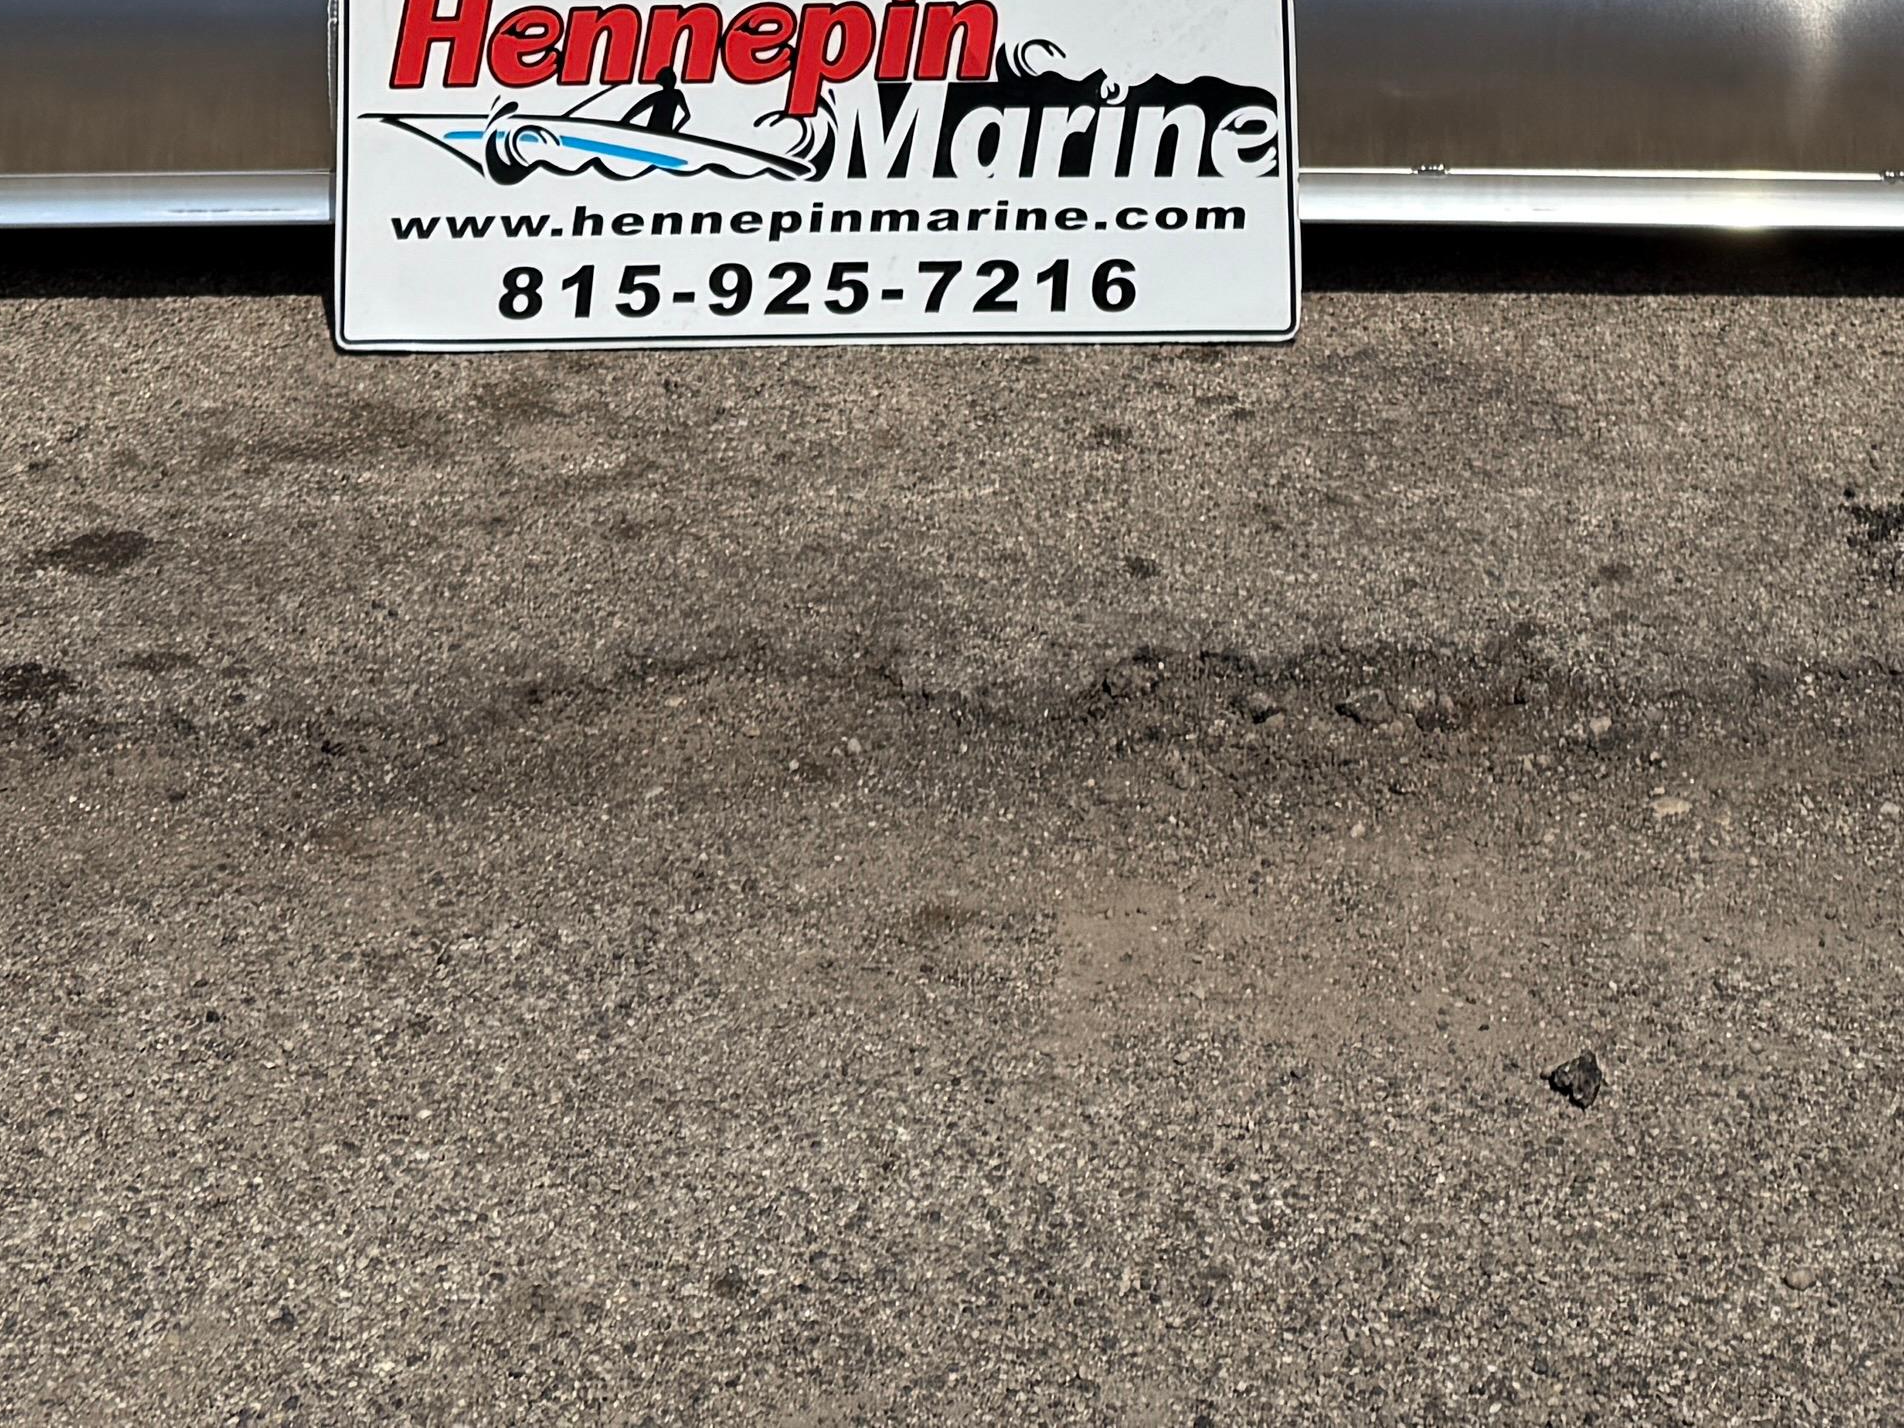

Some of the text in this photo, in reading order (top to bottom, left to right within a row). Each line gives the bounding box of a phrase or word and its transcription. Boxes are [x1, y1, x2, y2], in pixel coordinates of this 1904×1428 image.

[824, 71, 1280, 180] Marine
[392, 201, 1245, 241] www.hennepinmarine.com
[499, 259, 1135, 319] 815-925-7216
